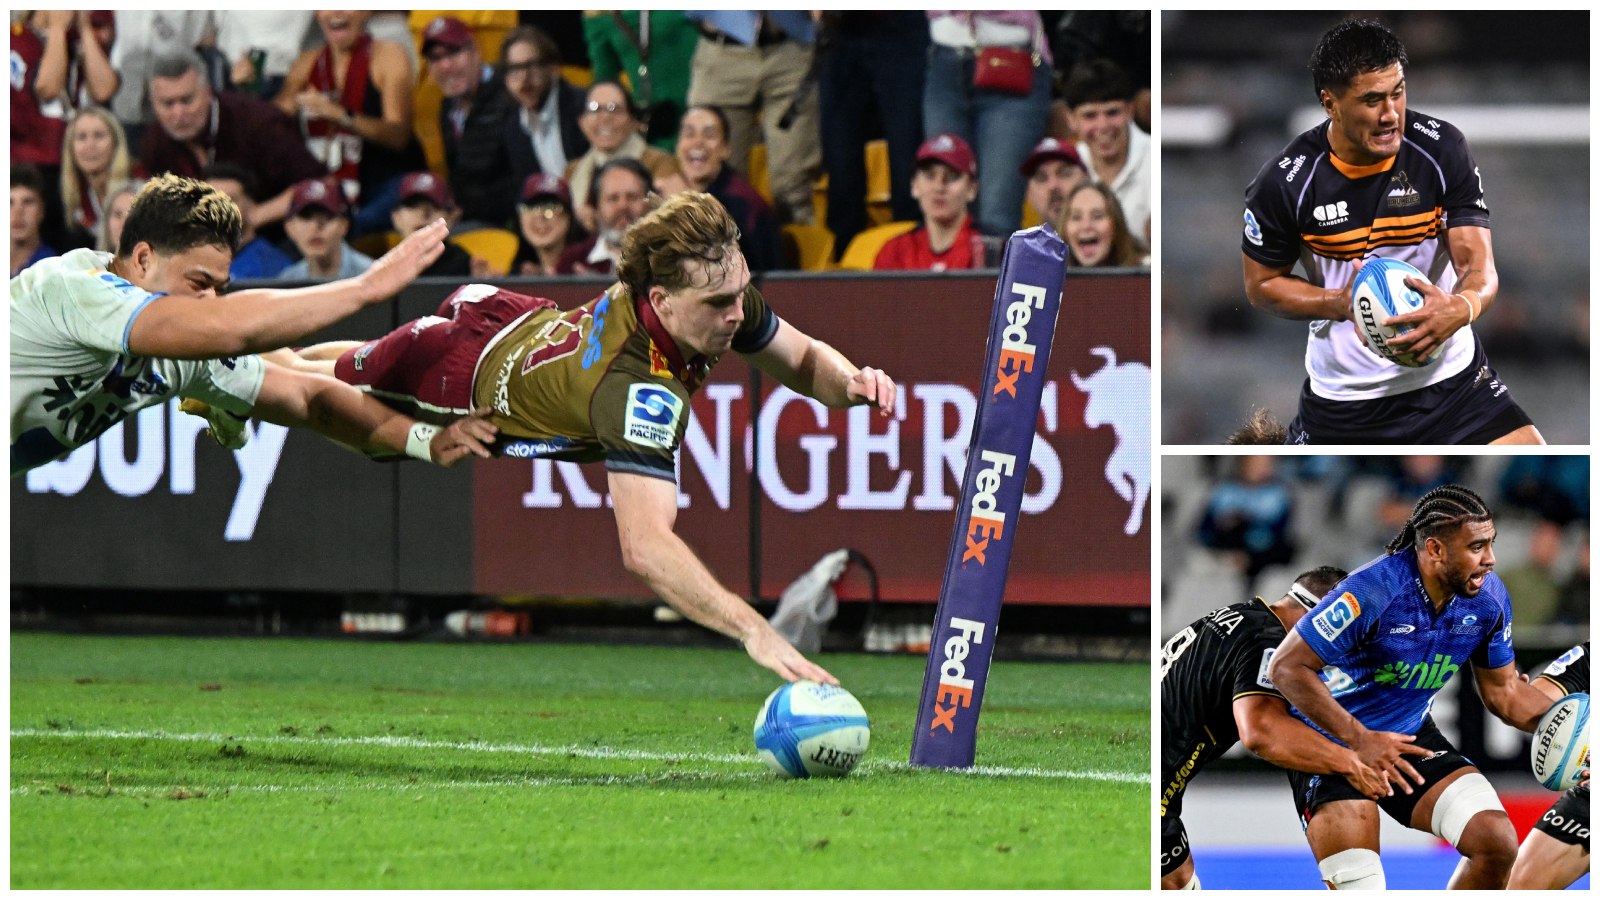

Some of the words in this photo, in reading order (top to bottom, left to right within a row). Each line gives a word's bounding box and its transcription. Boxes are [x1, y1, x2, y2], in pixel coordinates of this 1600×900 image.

[1413, 122, 1441, 141] oneills
[1285, 154, 1307, 183] oneills
[1318, 216, 1349, 227] CANBERRA
[993, 281, 1047, 399] FedEx
[1358, 296, 1402, 364] GILBE
[522, 381, 1064, 514] NGERS
[962, 449, 1017, 567] FedEx
[1415, 577, 1430, 604] DUVAL
[1315, 618, 1333, 639] PACIFIC
[1389, 624, 1411, 634] CLASSIC
[931, 616, 986, 735] FedEx
[1401, 653, 1460, 689] nib
[1535, 703, 1572, 777] GILBERT
